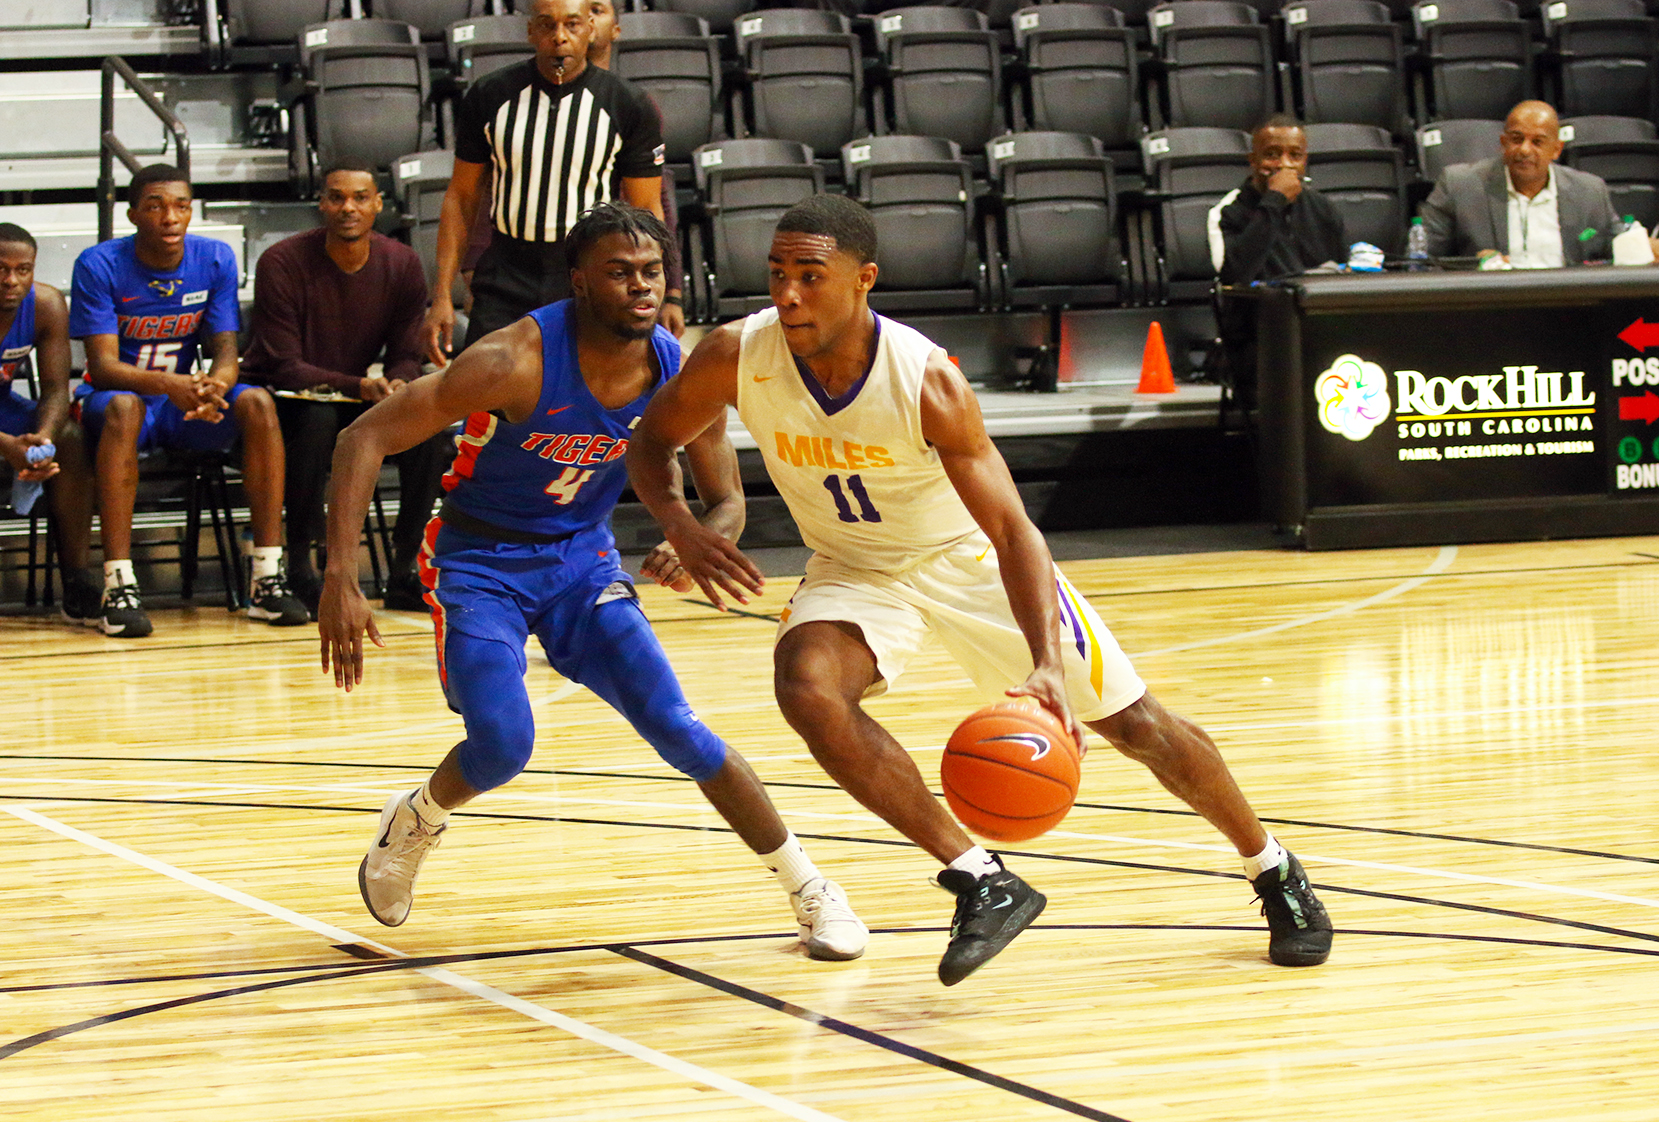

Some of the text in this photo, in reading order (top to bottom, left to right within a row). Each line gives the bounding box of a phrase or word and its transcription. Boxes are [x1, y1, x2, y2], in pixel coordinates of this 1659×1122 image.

[136, 342, 183, 373] 15
[1397, 415, 1594, 439] SOUTH CAROLINA
[520, 432, 629, 466] TIGER
[774, 430, 896, 470] MILES
[1398, 440, 1595, 461] PARKS, RECREATION & TOURISM
[543, 465, 596, 506] 4
[823, 474, 882, 523] 11
